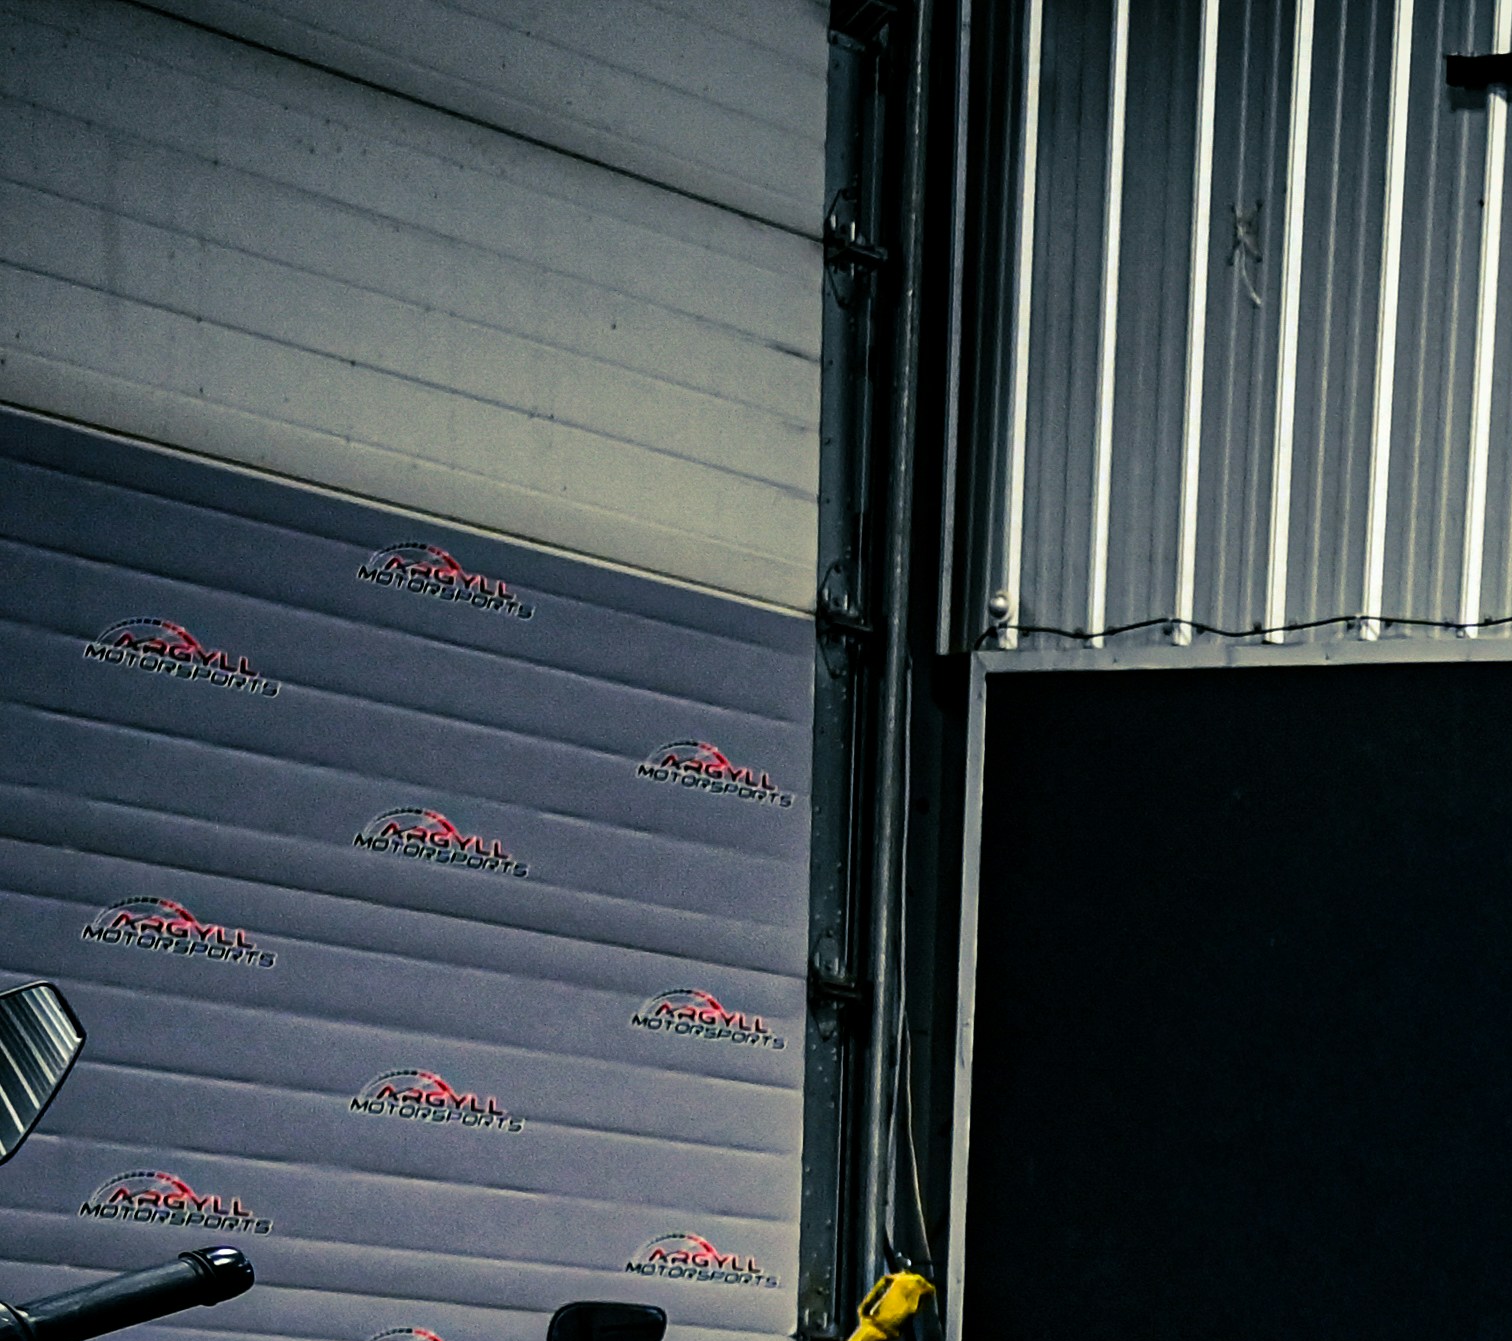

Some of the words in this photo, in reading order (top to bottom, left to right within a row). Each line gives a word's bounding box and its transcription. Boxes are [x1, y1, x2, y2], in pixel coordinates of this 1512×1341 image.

[357, 565, 536, 620] MOTORSPORTS
[385, 556, 516, 600] ARGYLL
[83, 643, 281, 699] MOTORSPORTS
[114, 633, 259, 677] ARGYLL
[637, 764, 795, 808] MOTORSPORTS
[661, 754, 776, 790] ARGYLL
[354, 832, 528, 878] MOTORSPORTS
[380, 822, 510, 861] ARGYLL
[82, 923, 275, 969] MOTORSPORTS
[112, 913, 255, 951] ARGYLL
[631, 1014, 785, 1050] MOTORSPORTS
[654, 1005, 769, 1034] ARGYLL
[350, 1096, 525, 1133] MOTORSPORTS
[377, 1084, 504, 1117] ARGYLL
[79, 1199, 272, 1235] MOTORSPORTS
[107, 1186, 251, 1217] ARGYLL
[625, 1261, 780, 1288] MOTORSPORTS
[648, 1249, 762, 1274] ARGYLL
